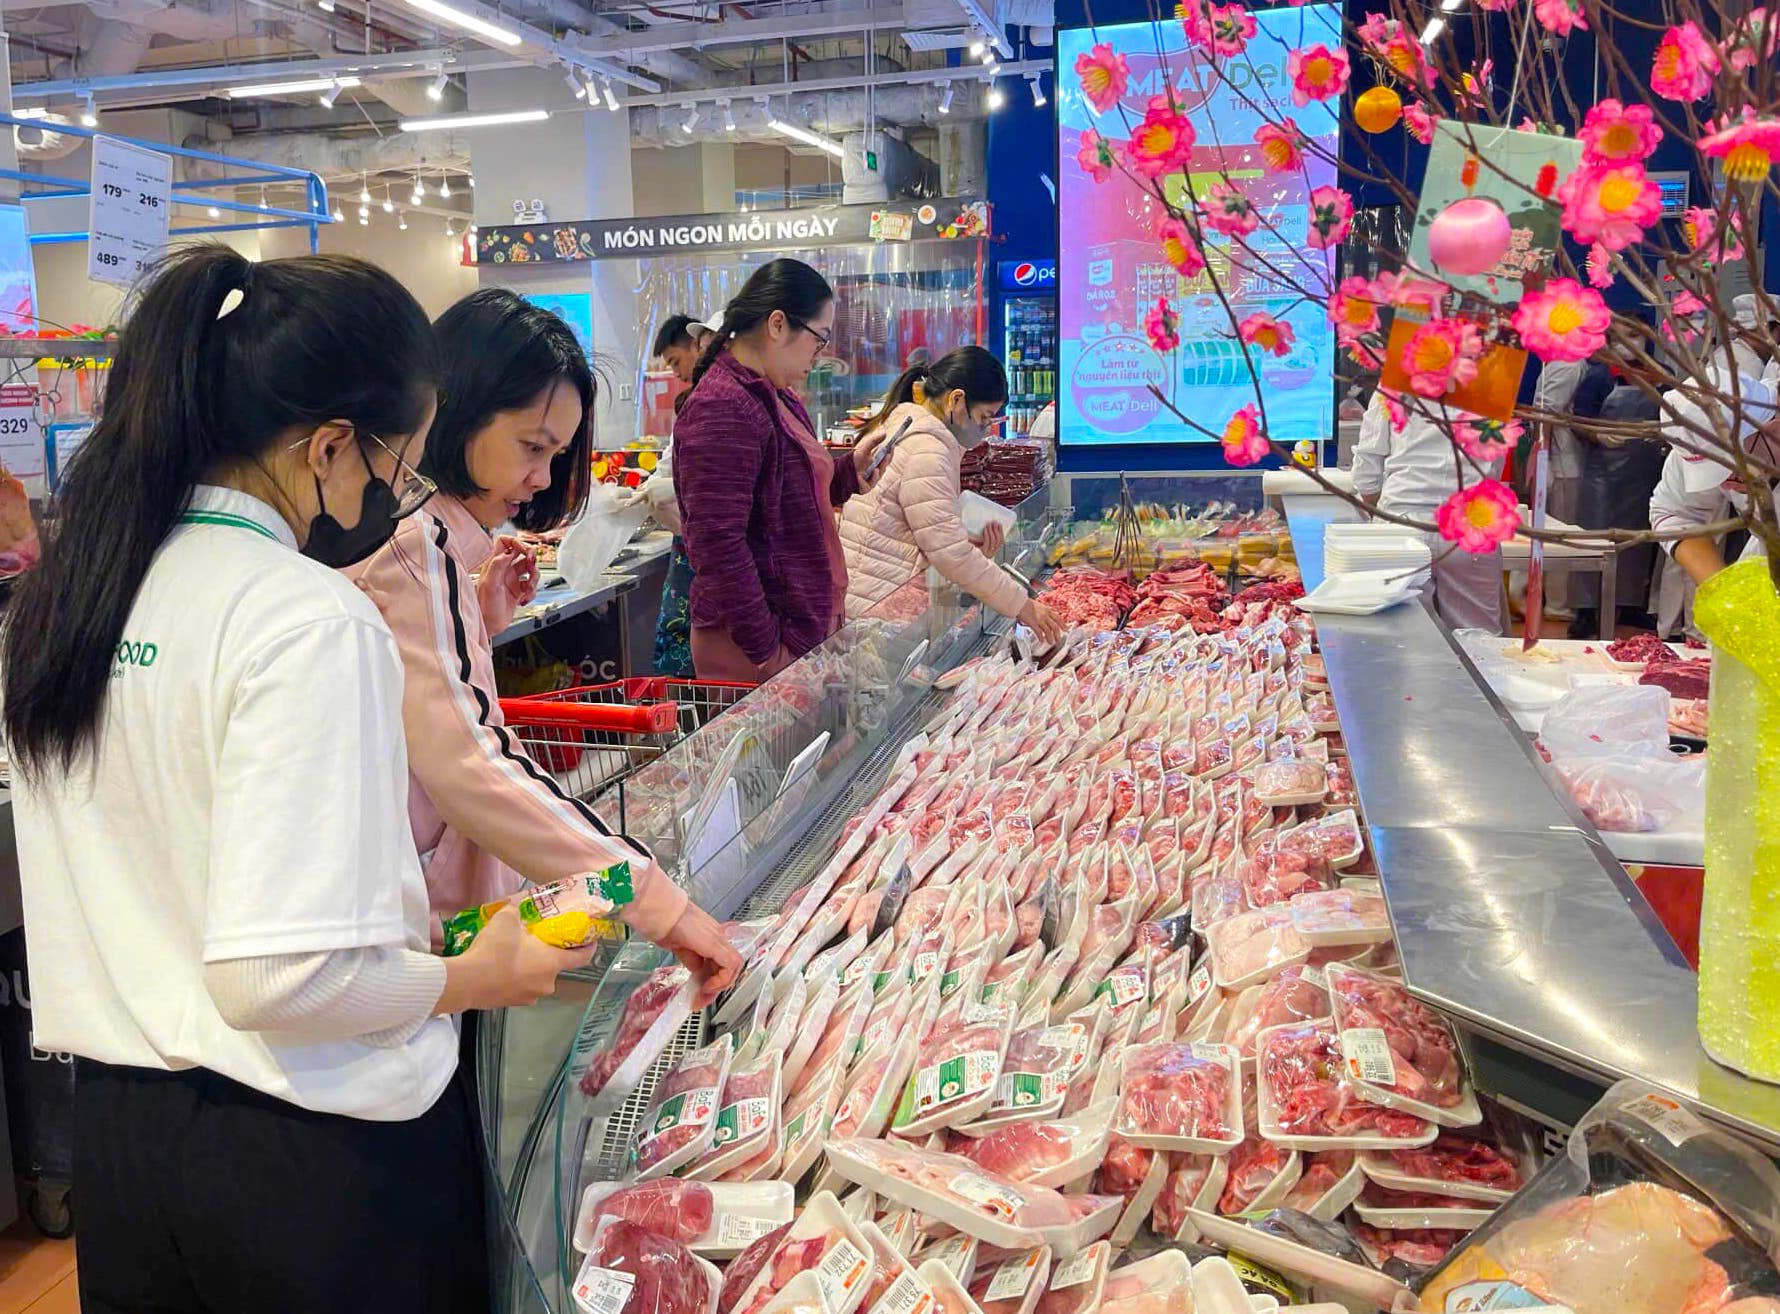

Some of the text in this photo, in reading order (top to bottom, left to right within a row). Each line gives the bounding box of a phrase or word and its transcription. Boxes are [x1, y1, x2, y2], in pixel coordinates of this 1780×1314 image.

[1229, 55, 1290, 90] Del
[102, 183, 122, 198] 179
[139, 193, 159, 207] 216
[604, 214, 839, 249] MÓN NGON MỖI NGÀY
[96, 252, 119, 266] 489
[0, 418, 29, 434] 329
[116, 640, 158, 667] OOD
